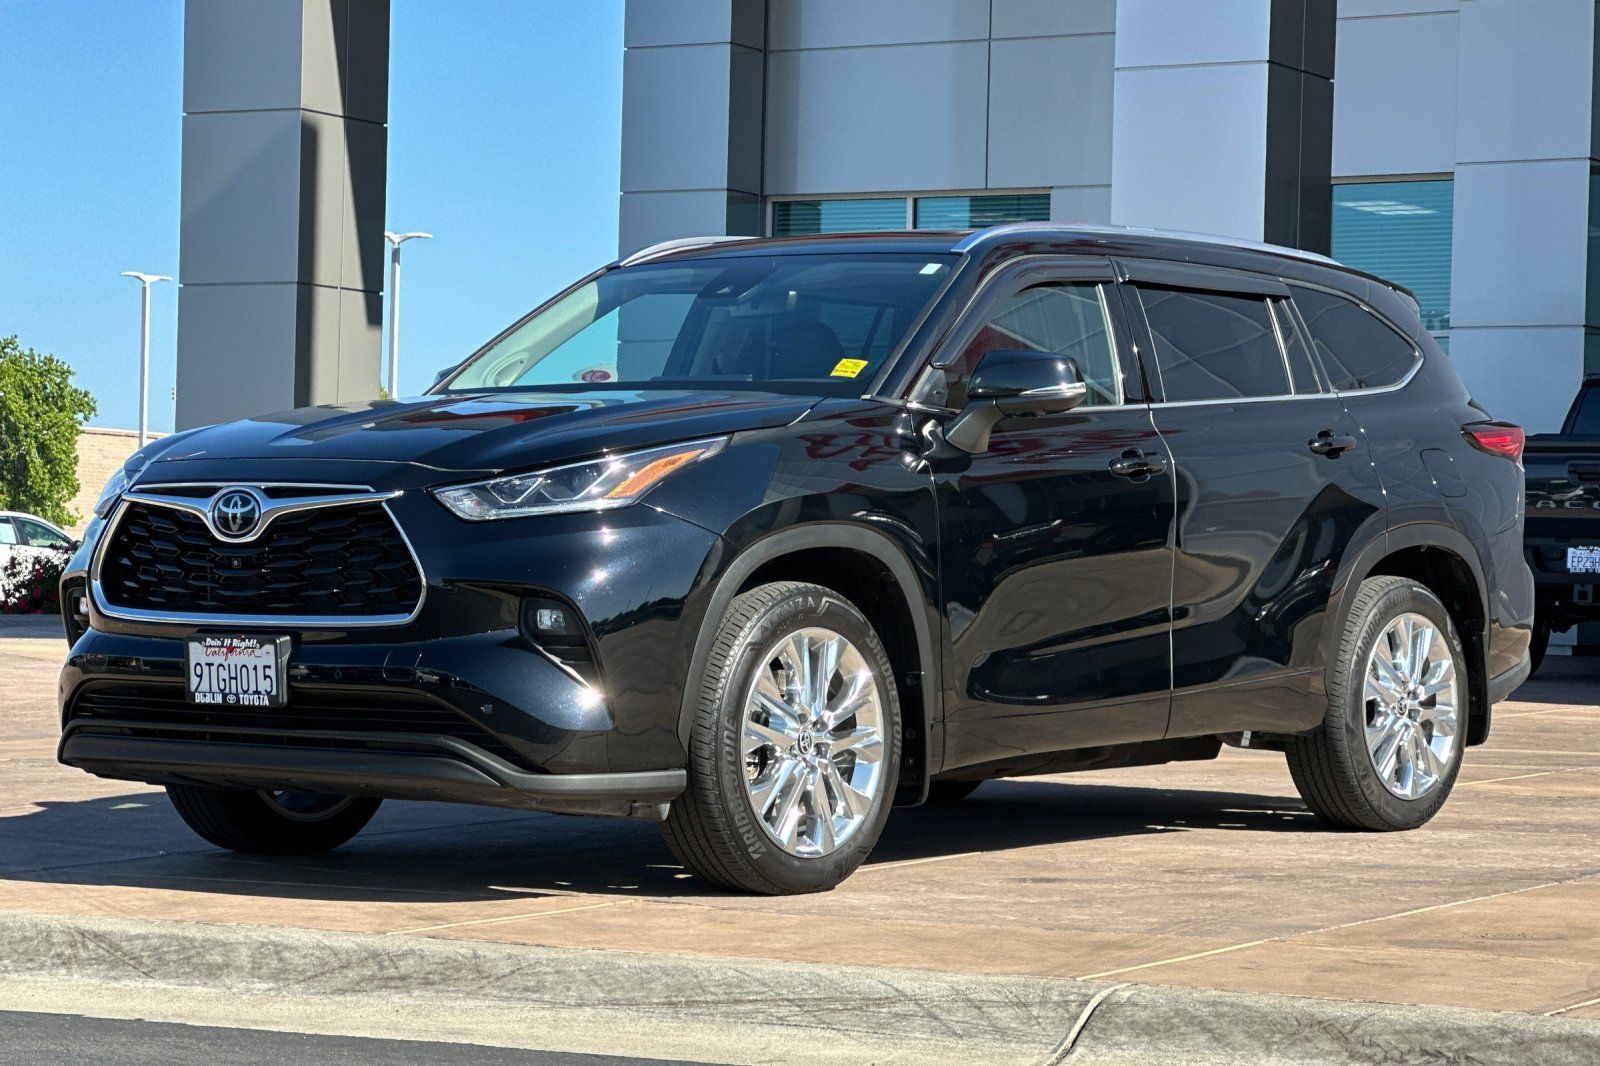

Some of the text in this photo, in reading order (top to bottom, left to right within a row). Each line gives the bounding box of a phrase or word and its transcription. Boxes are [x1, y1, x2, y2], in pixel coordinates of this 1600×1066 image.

[232, 638, 257, 650] Right!
[193, 662, 274, 695] 9TGH015
[195, 692, 270, 706] DUBLIN TOYOTA
